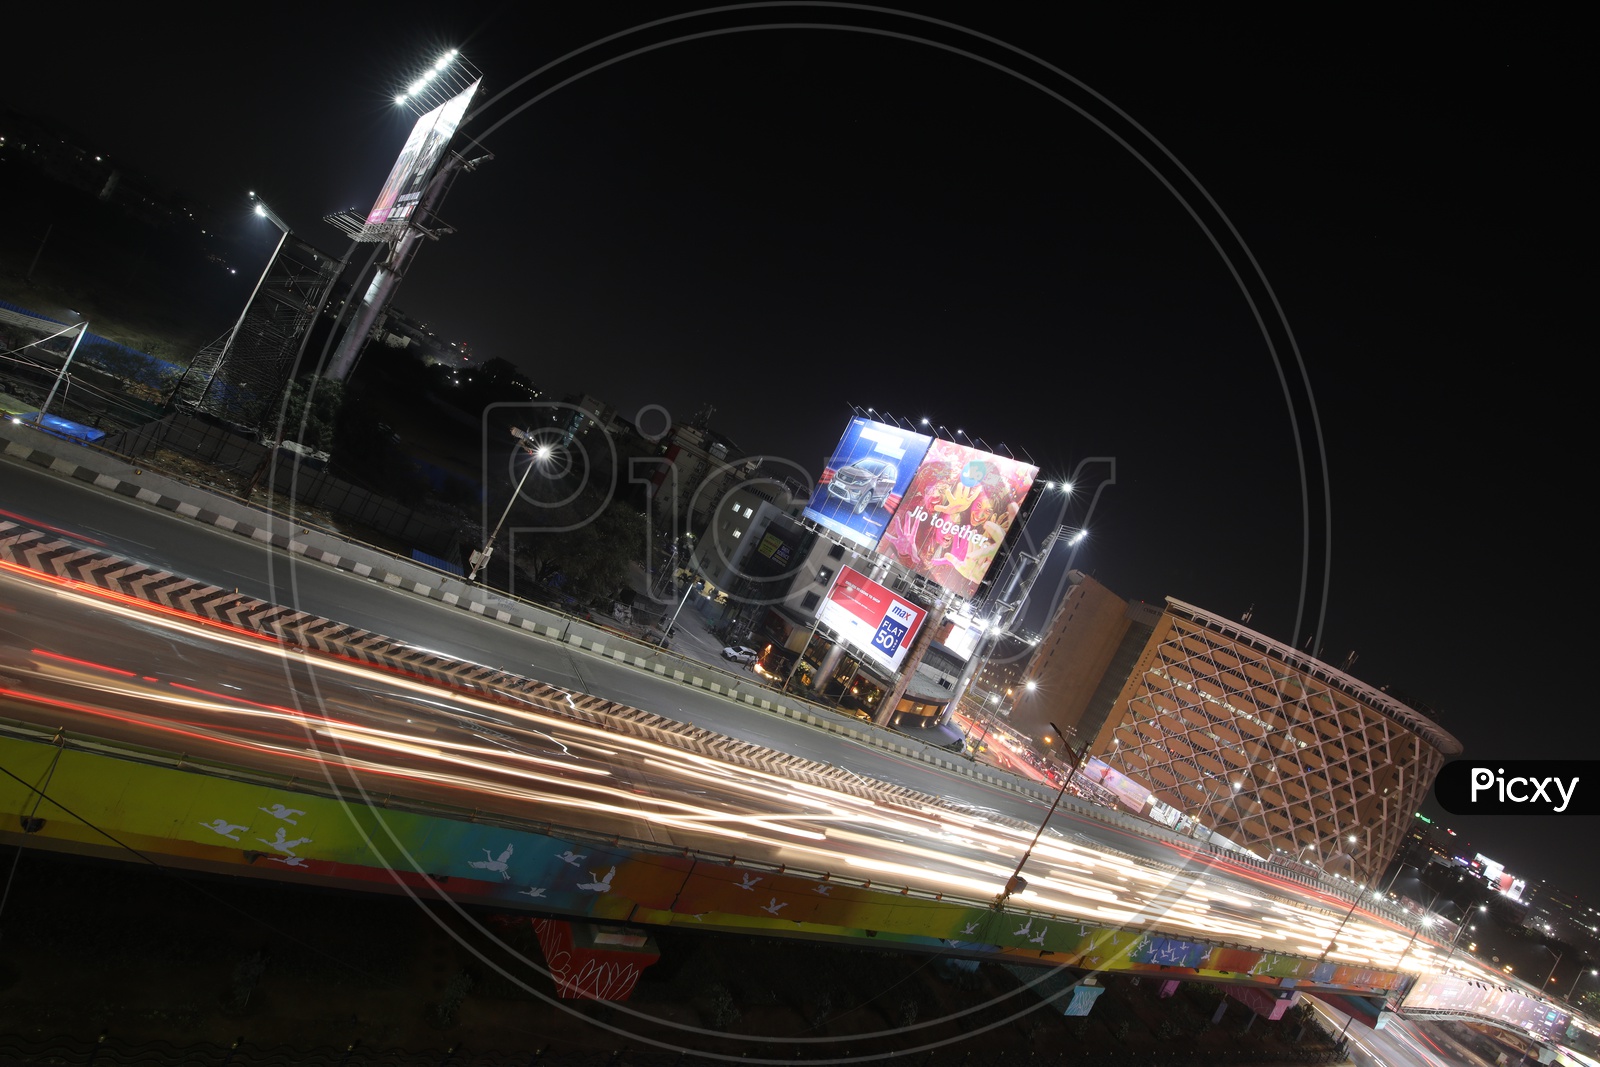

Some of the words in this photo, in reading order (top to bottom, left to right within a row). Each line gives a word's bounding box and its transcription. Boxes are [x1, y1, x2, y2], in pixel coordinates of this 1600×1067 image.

[910, 505, 928, 522] Jio
[892, 606, 911, 621] max
[882, 620, 904, 637] FLAT
[876, 630, 894, 648] 50
